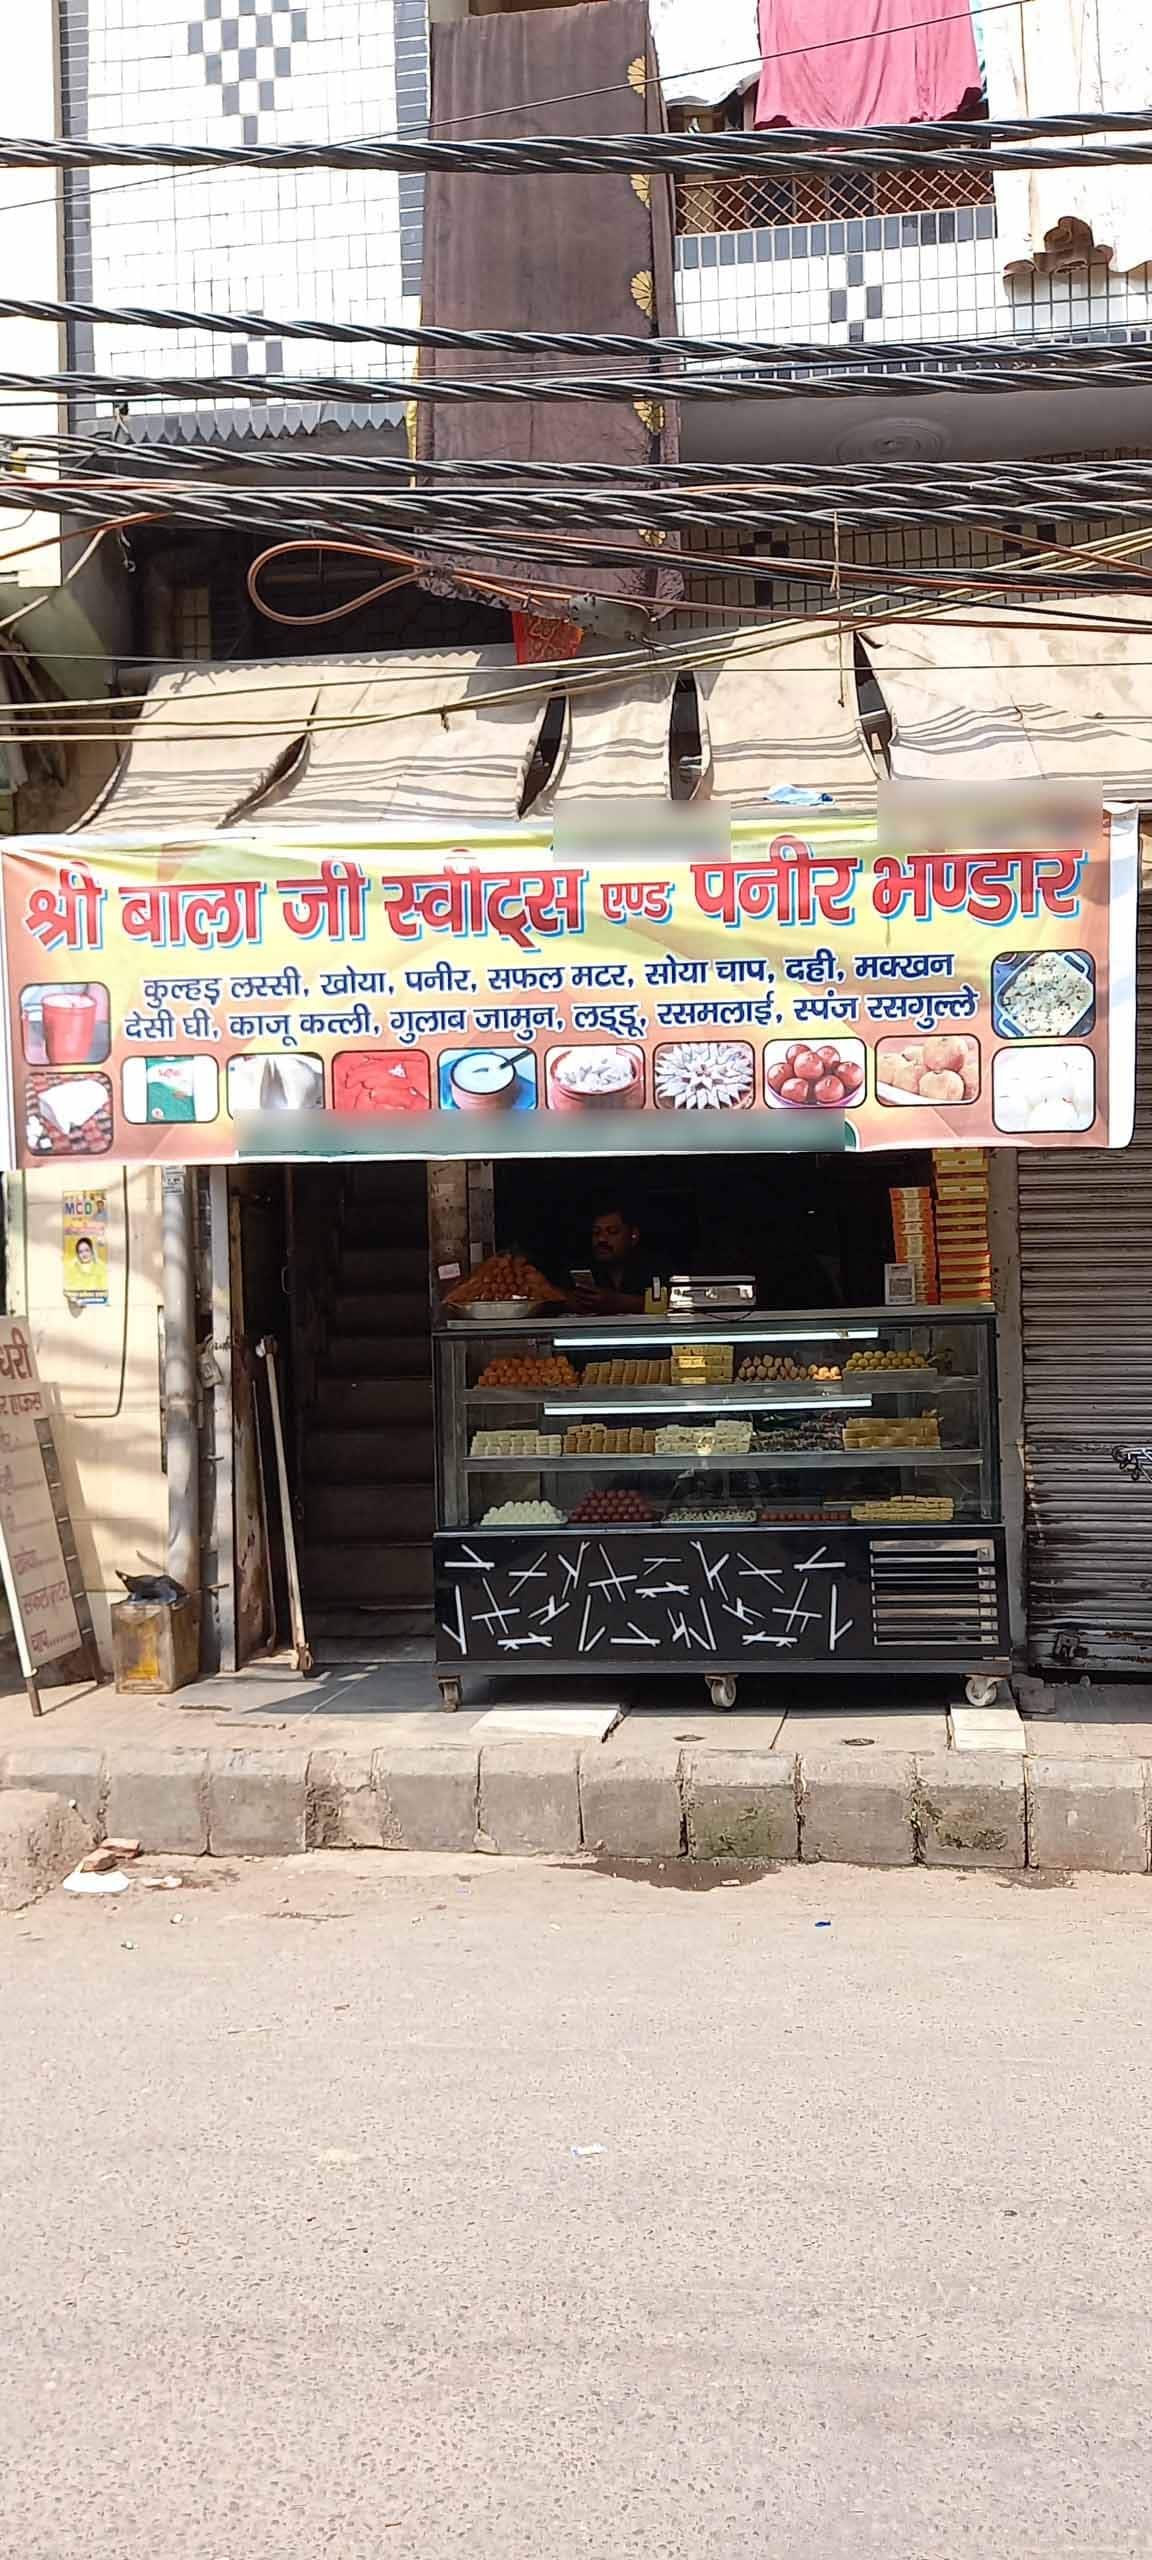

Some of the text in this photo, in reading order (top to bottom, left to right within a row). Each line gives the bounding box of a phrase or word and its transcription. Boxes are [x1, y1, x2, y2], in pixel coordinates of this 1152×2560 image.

[26, 835, 1088, 952] श्री बाला जी स्वीट्स एण्ड पनीर भण्डार
[143, 948, 955, 1009] कुल्हड़ लस्सी, खोया, पनीर, सफल मटर, सोया चाप, दही, मक्खन
[124, 1007, 174, 1039] देसी
[183, 1007, 219, 1039] घी,
[228, 1014, 297, 1046] काजू
[300, 1003, 380, 1035] कत्ली,
[390, 1009, 467, 1042] गुलाब
[473, 1006, 564, 1040] जामुन,
[657, 990, 783, 1024] रसमलाई,
[793, 989, 859, 1020] स्पंज
[867, 985, 979, 1029] रसगुल्ले
[64, 1201, 93, 1215] MCD
